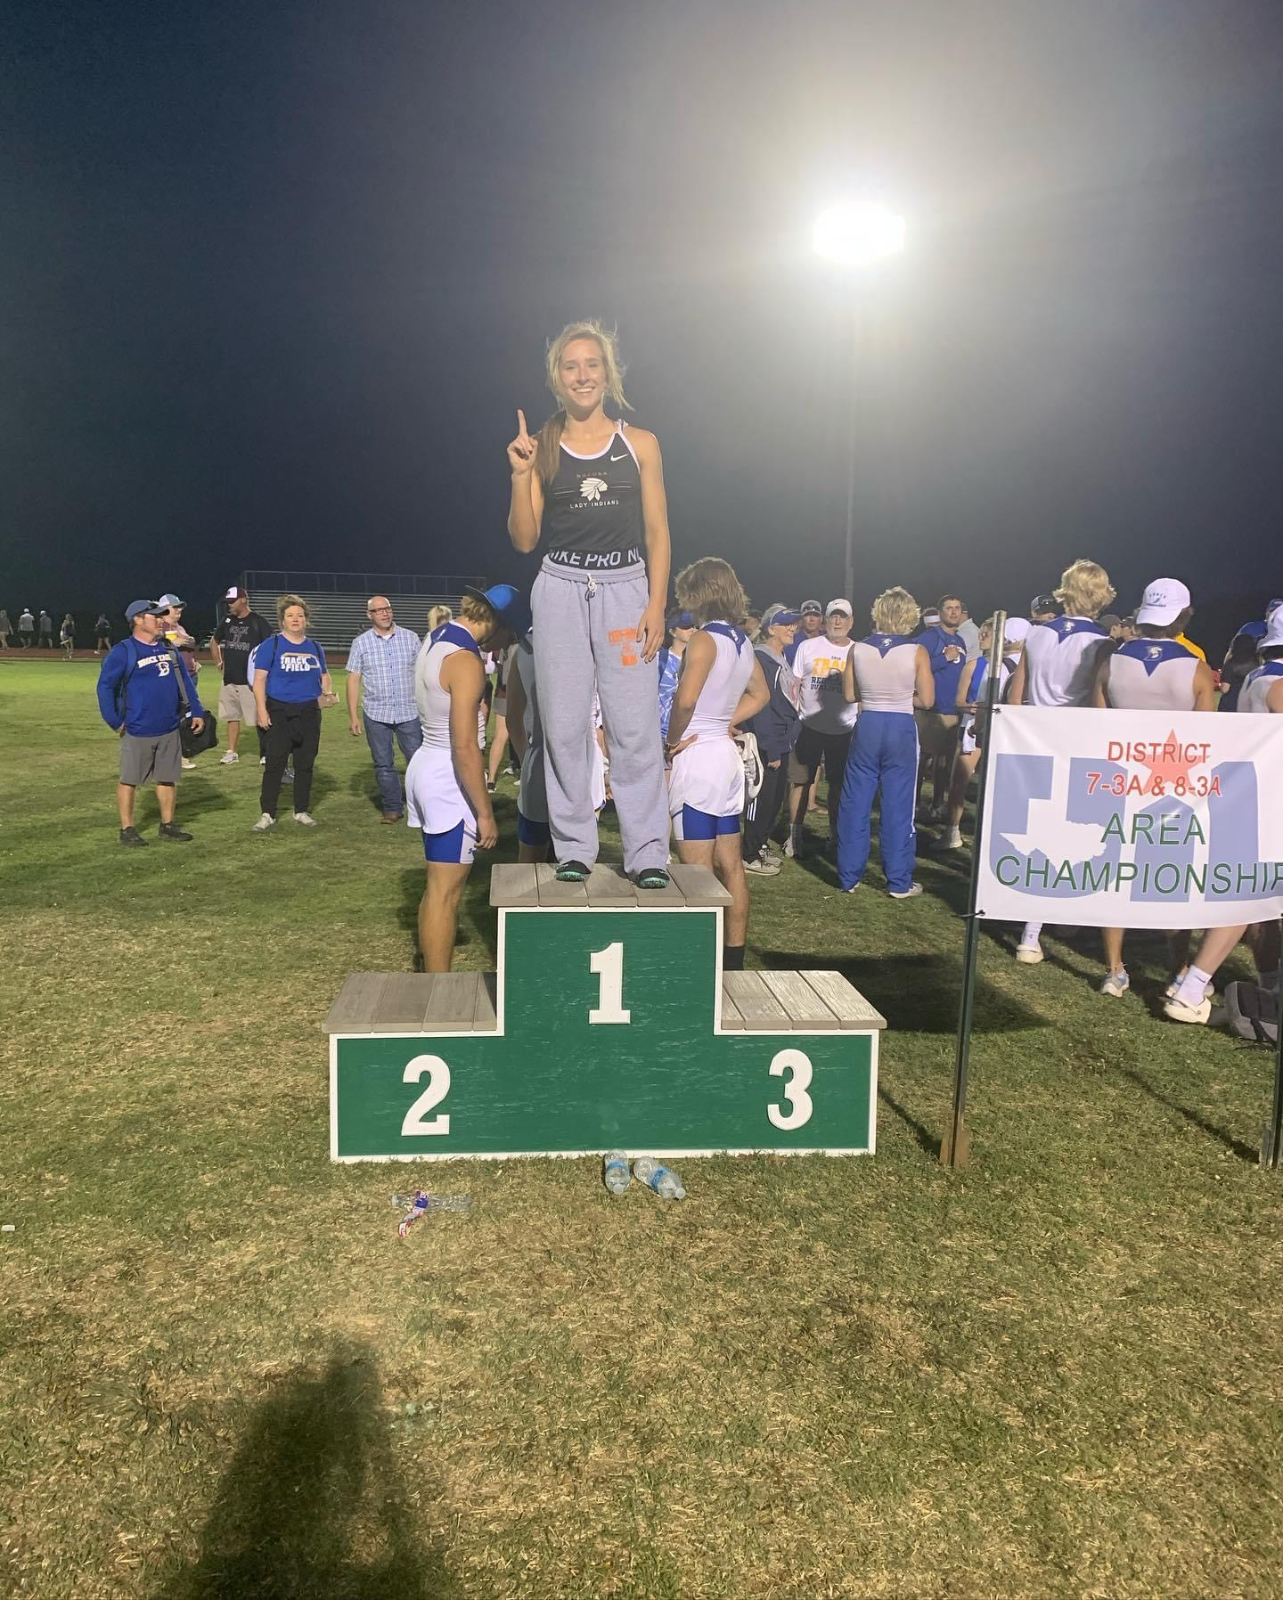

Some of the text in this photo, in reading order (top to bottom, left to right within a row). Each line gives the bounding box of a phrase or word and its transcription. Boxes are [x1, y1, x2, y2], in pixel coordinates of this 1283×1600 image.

[591, 499, 619, 507] INDIANS
[584, 551, 621, 568] PRO
[280, 655, 307, 665] TRACK
[285, 664, 310, 672] FIELD
[1107, 741, 1211, 763] DISTRICT
[1086, 773, 1222, 797] 7-3A & 8-3A
[1100, 812, 1206, 845] AREA
[589, 942, 630, 1025] 1
[401, 1055, 451, 1136] 2
[767, 1049, 813, 1131] 3
